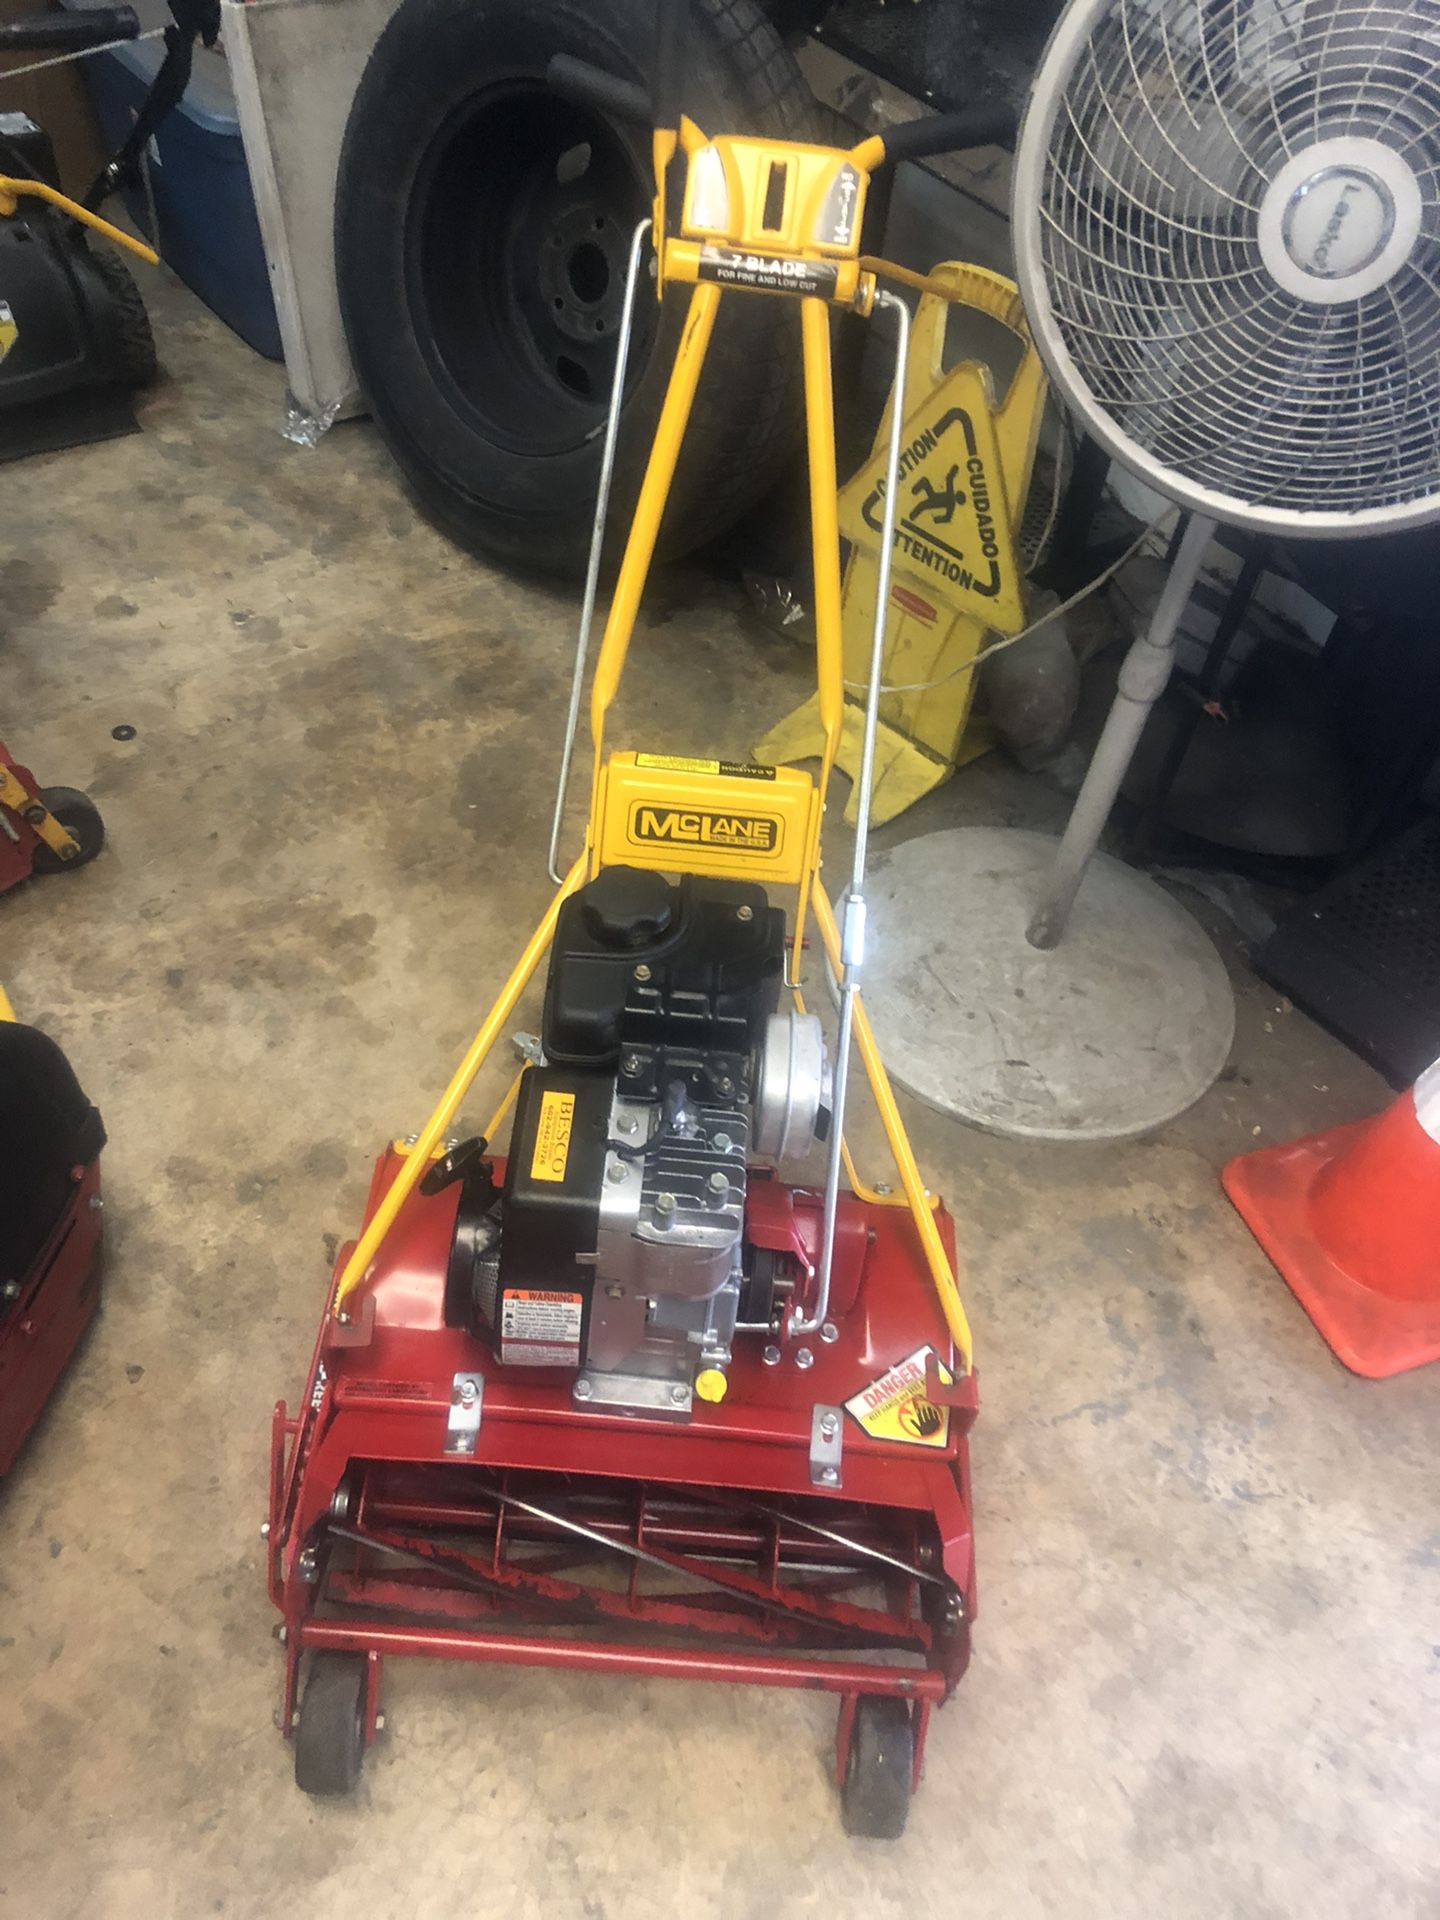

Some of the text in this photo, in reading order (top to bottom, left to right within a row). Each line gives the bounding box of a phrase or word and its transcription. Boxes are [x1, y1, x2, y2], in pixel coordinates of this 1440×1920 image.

[1313, 184, 1361, 263] Lasko
[717, 268, 817, 291] FOR FINE AND LOW CUT
[732, 254, 808, 278] 7 BLADE
[965, 457, 999, 558] CUIDADO
[892, 529, 974, 591] TTENTION
[551, 1101, 573, 1173] BESCO
[528, 1292, 575, 1303] WARNING
[862, 1361, 924, 1410] DANGER
